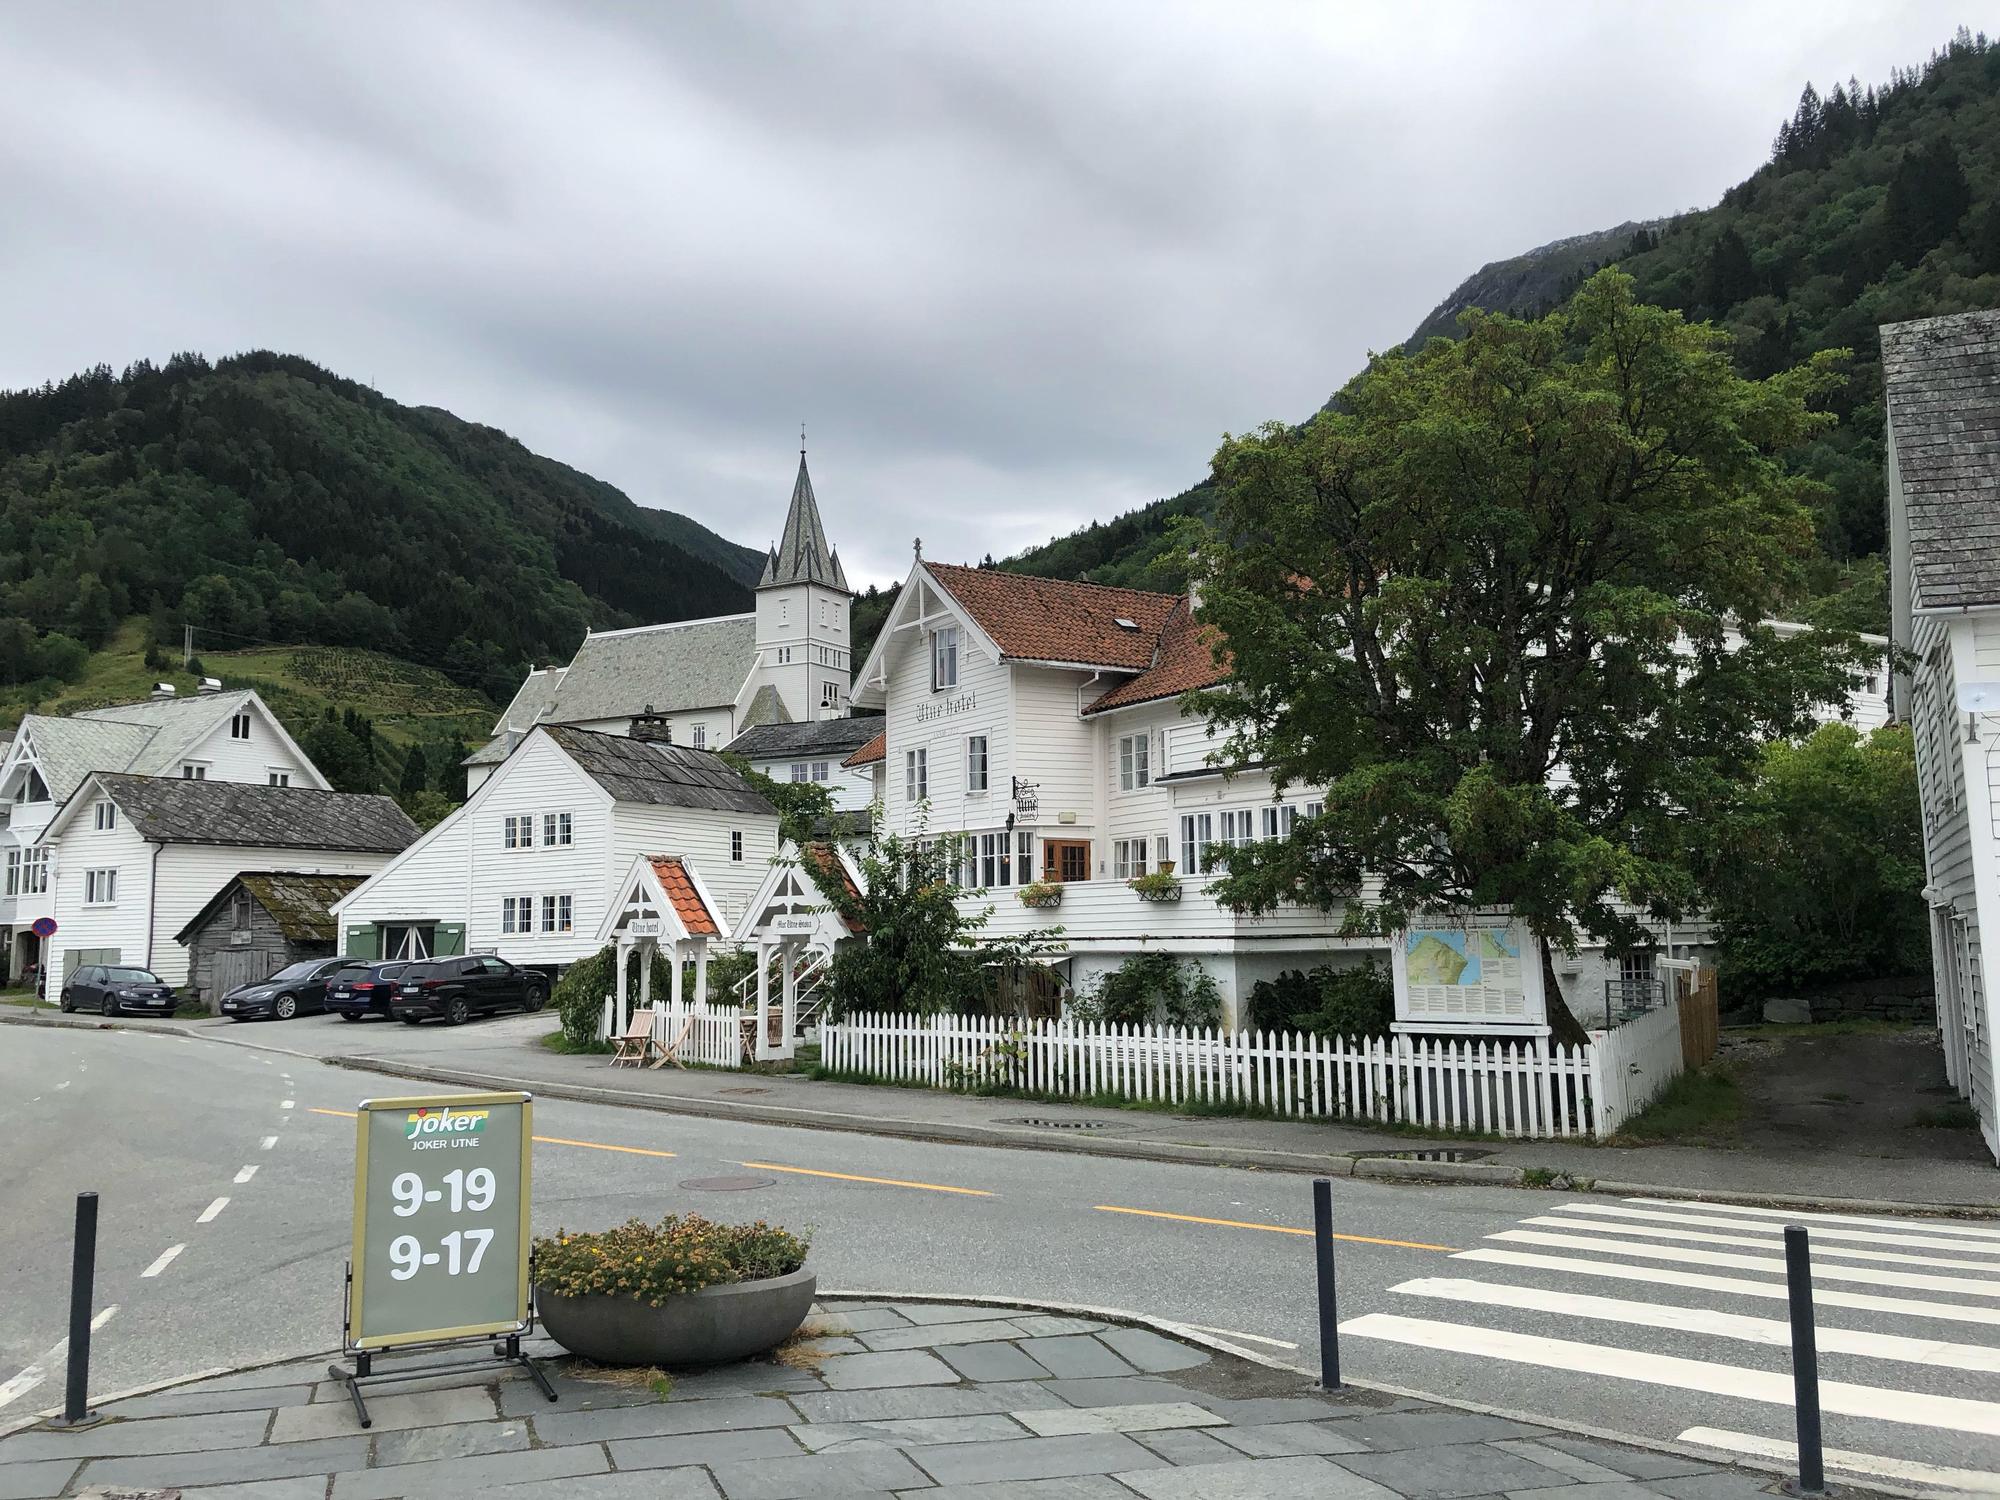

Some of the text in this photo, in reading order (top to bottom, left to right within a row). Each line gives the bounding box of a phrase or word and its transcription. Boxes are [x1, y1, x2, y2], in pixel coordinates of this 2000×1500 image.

[412, 1137, 480, 1151] JOKER UTNE
[391, 1167, 496, 1217] 9-19
[389, 1228, 495, 1281] 9-17
